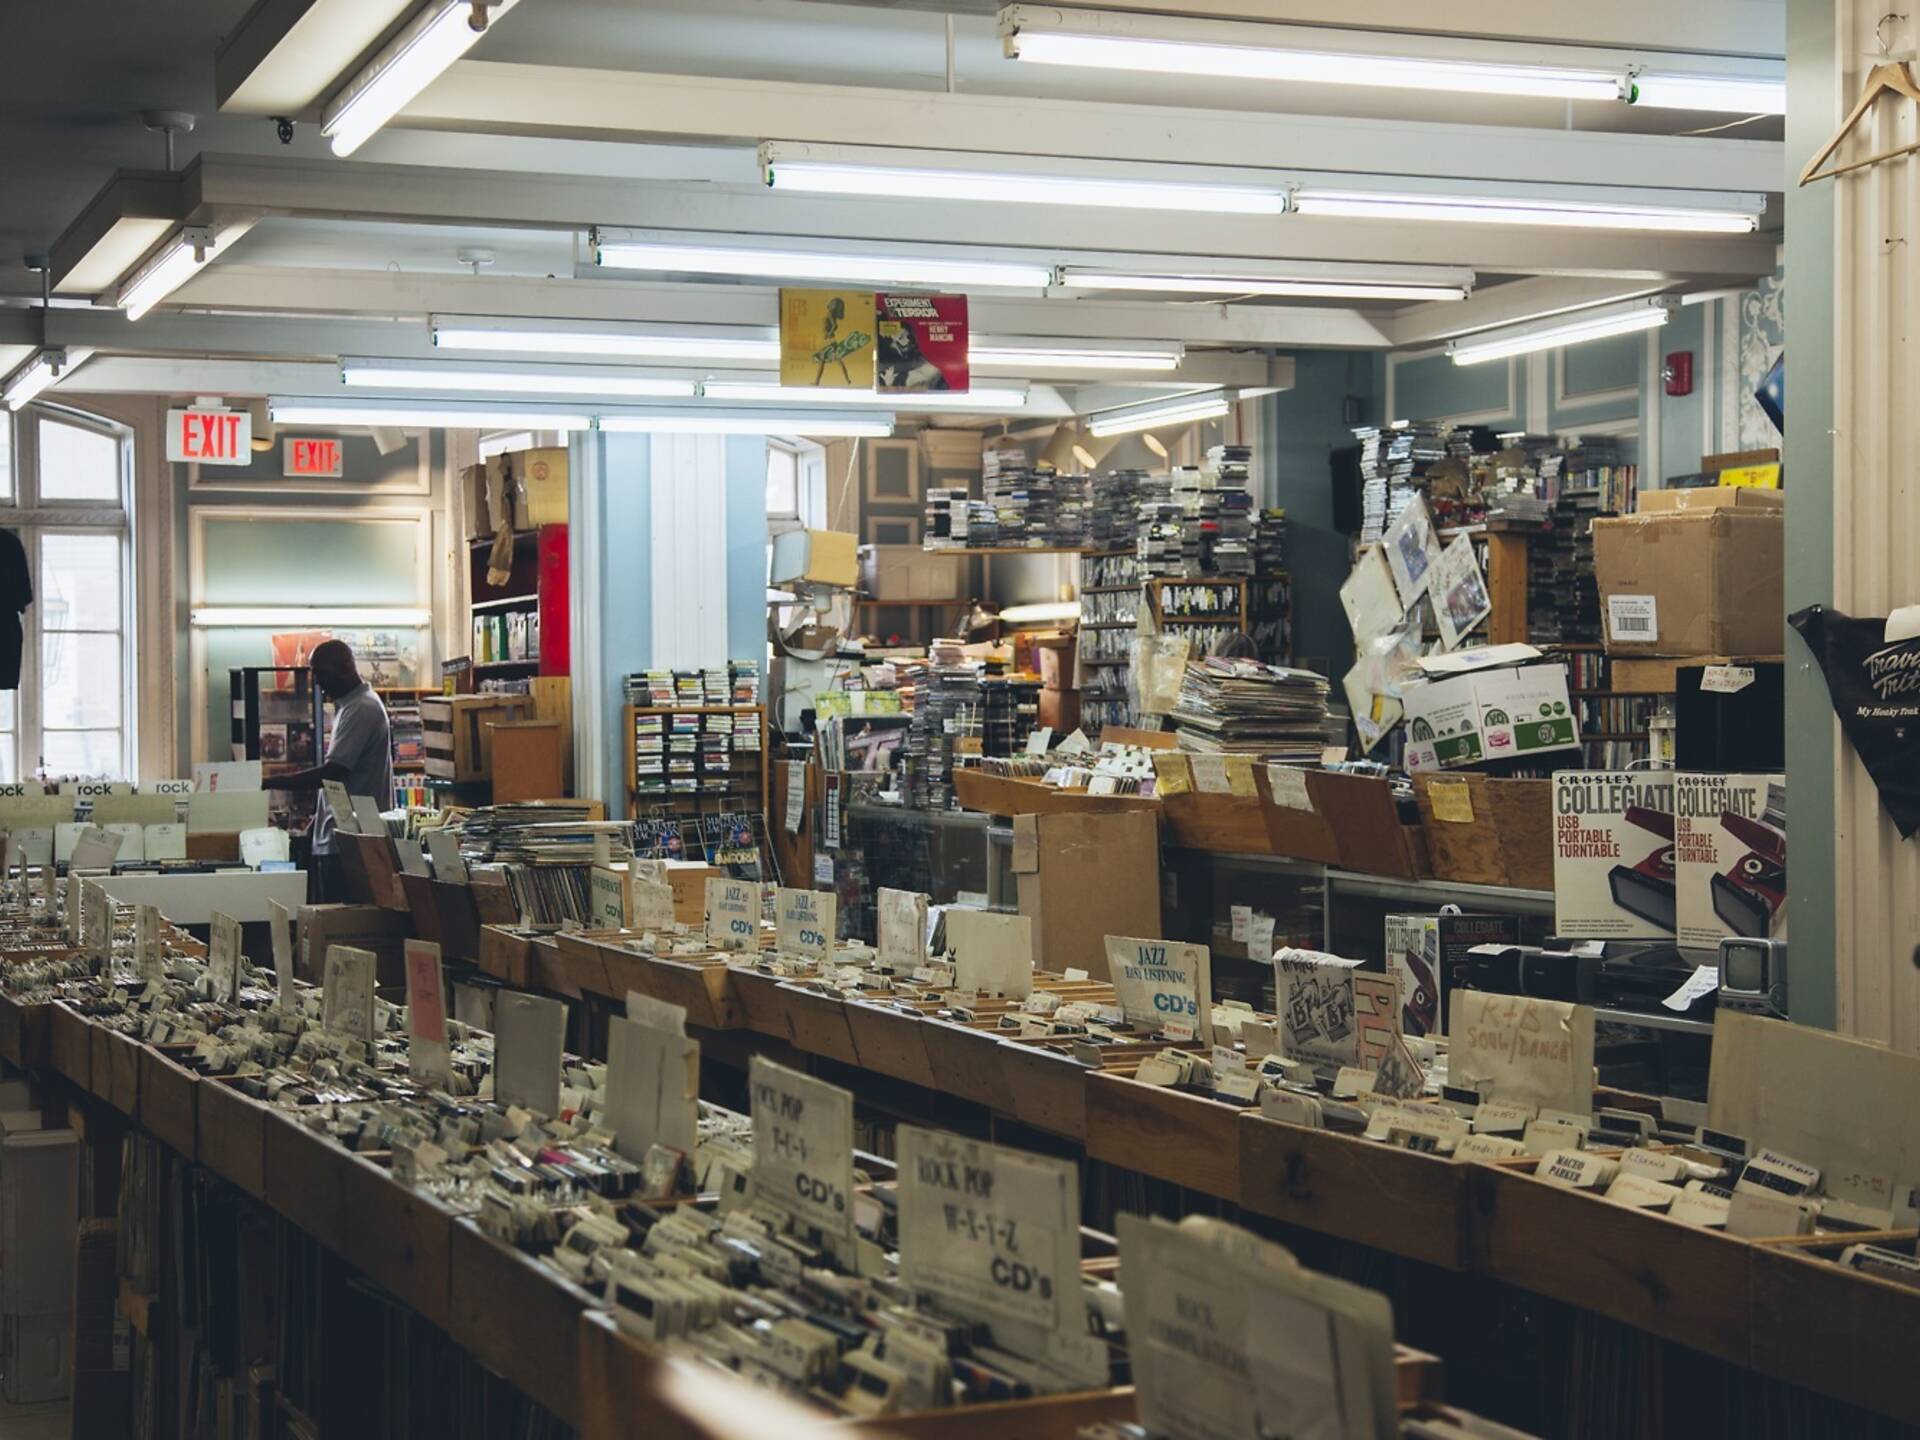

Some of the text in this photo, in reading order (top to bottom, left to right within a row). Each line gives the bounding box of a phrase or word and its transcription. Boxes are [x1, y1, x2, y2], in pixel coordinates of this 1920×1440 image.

[884, 297, 932, 308] EXPERIMENT
[894, 308, 939, 318] TERROR
[182, 414, 241, 459] EXIT
[293, 439, 336, 474] EXIT
[1856, 706, 1871, 718] My
[155, 780, 190, 793] rock
[1558, 775, 1634, 785] CROSLEY
[1677, 776, 1727, 787] CROSLEY
[77, 783, 113, 796] rock
[1557, 815, 1580, 829] USB
[1677, 818, 1692, 832] USB
[1557, 829, 1613, 843] PORTABLE
[1677, 833, 1713, 849] PORTABLE
[1557, 843, 1621, 858] TURNTABLE
[1677, 848, 1719, 864] TURNTABLE
[726, 886, 741, 900] JAZZ
[794, 894, 807, 907] JAZZ
[730, 919, 754, 935] CD's
[799, 928, 825, 945] CD's
[1137, 945, 1168, 966] JAZZ
[1124, 966, 1187, 984] EASY LISTENING
[1153, 993, 1197, 1016] CD's
[1556, 1152, 1586, 1171] MACEO
[963, 1164, 993, 1199] POP
[1547, 1165, 1582, 1184] PARKER
[795, 1171, 846, 1213] CD's
[990, 1257, 1052, 1301] CD's
